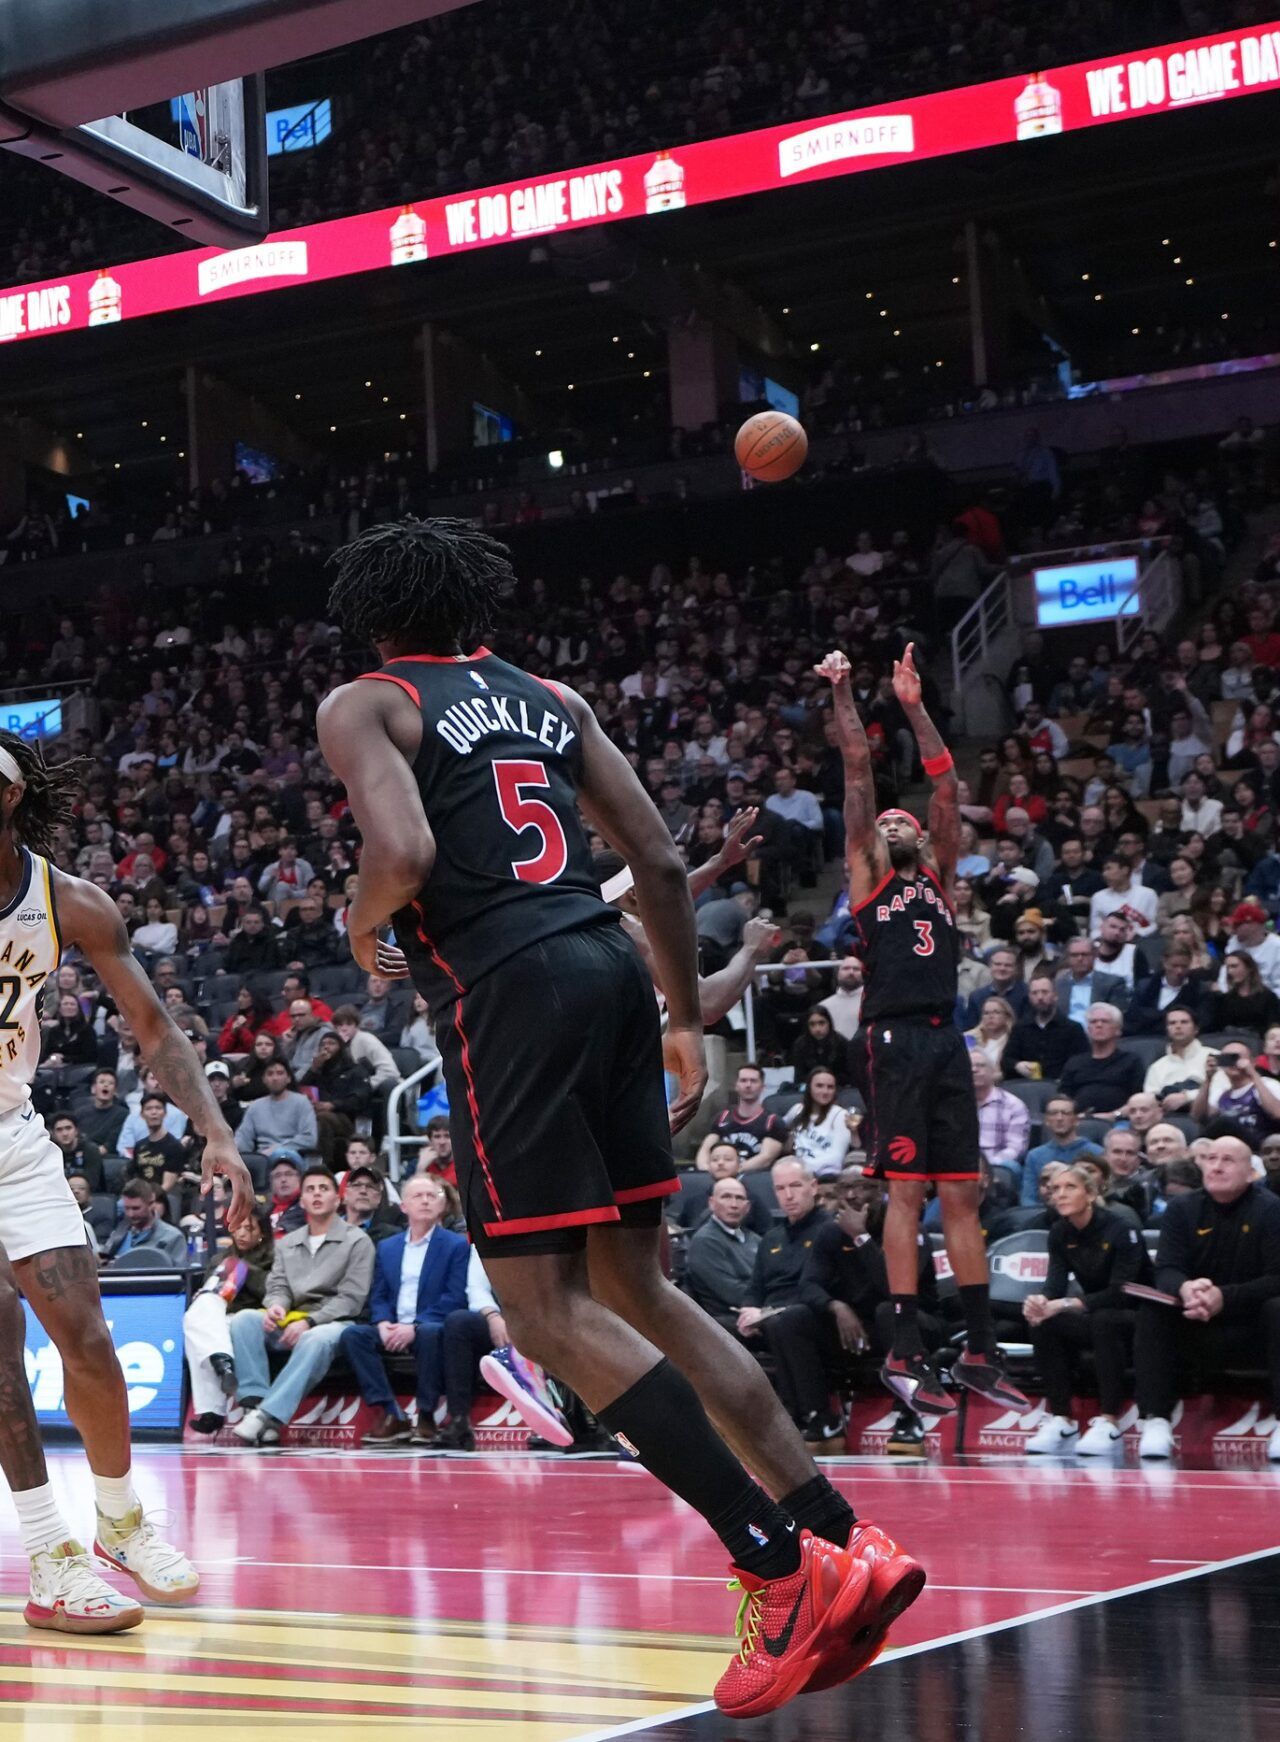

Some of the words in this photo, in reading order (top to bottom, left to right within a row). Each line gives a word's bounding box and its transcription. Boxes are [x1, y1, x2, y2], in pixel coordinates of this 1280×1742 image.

[1085, 64, 1127, 117] WE
[1127, 57, 1166, 109] DO
[1167, 40, 1240, 101] GAME
[1240, 30, 1280, 86] DA
[792, 125, 900, 162] SMIRNOFF
[445, 199, 478, 246] WE
[478, 193, 509, 240] DO
[510, 179, 569, 233] GAME
[569, 169, 624, 221] DAYS
[209, 249, 297, 283] SMIRNOFF
[27, 285, 71, 331] DAYS
[1059, 573, 1115, 609] Bell
[436, 696, 576, 755] QUICKLEY
[491, 759, 568, 885] 5
[17, 912, 36, 922] LUCAS
[37, 912, 48, 920] OIL
[877, 881, 953, 926] RAPTORS
[913, 920, 935, 956] 3
[288, 1429, 355, 1440] MAGELLAN
[474, 1431, 531, 1442] MAGELLA
